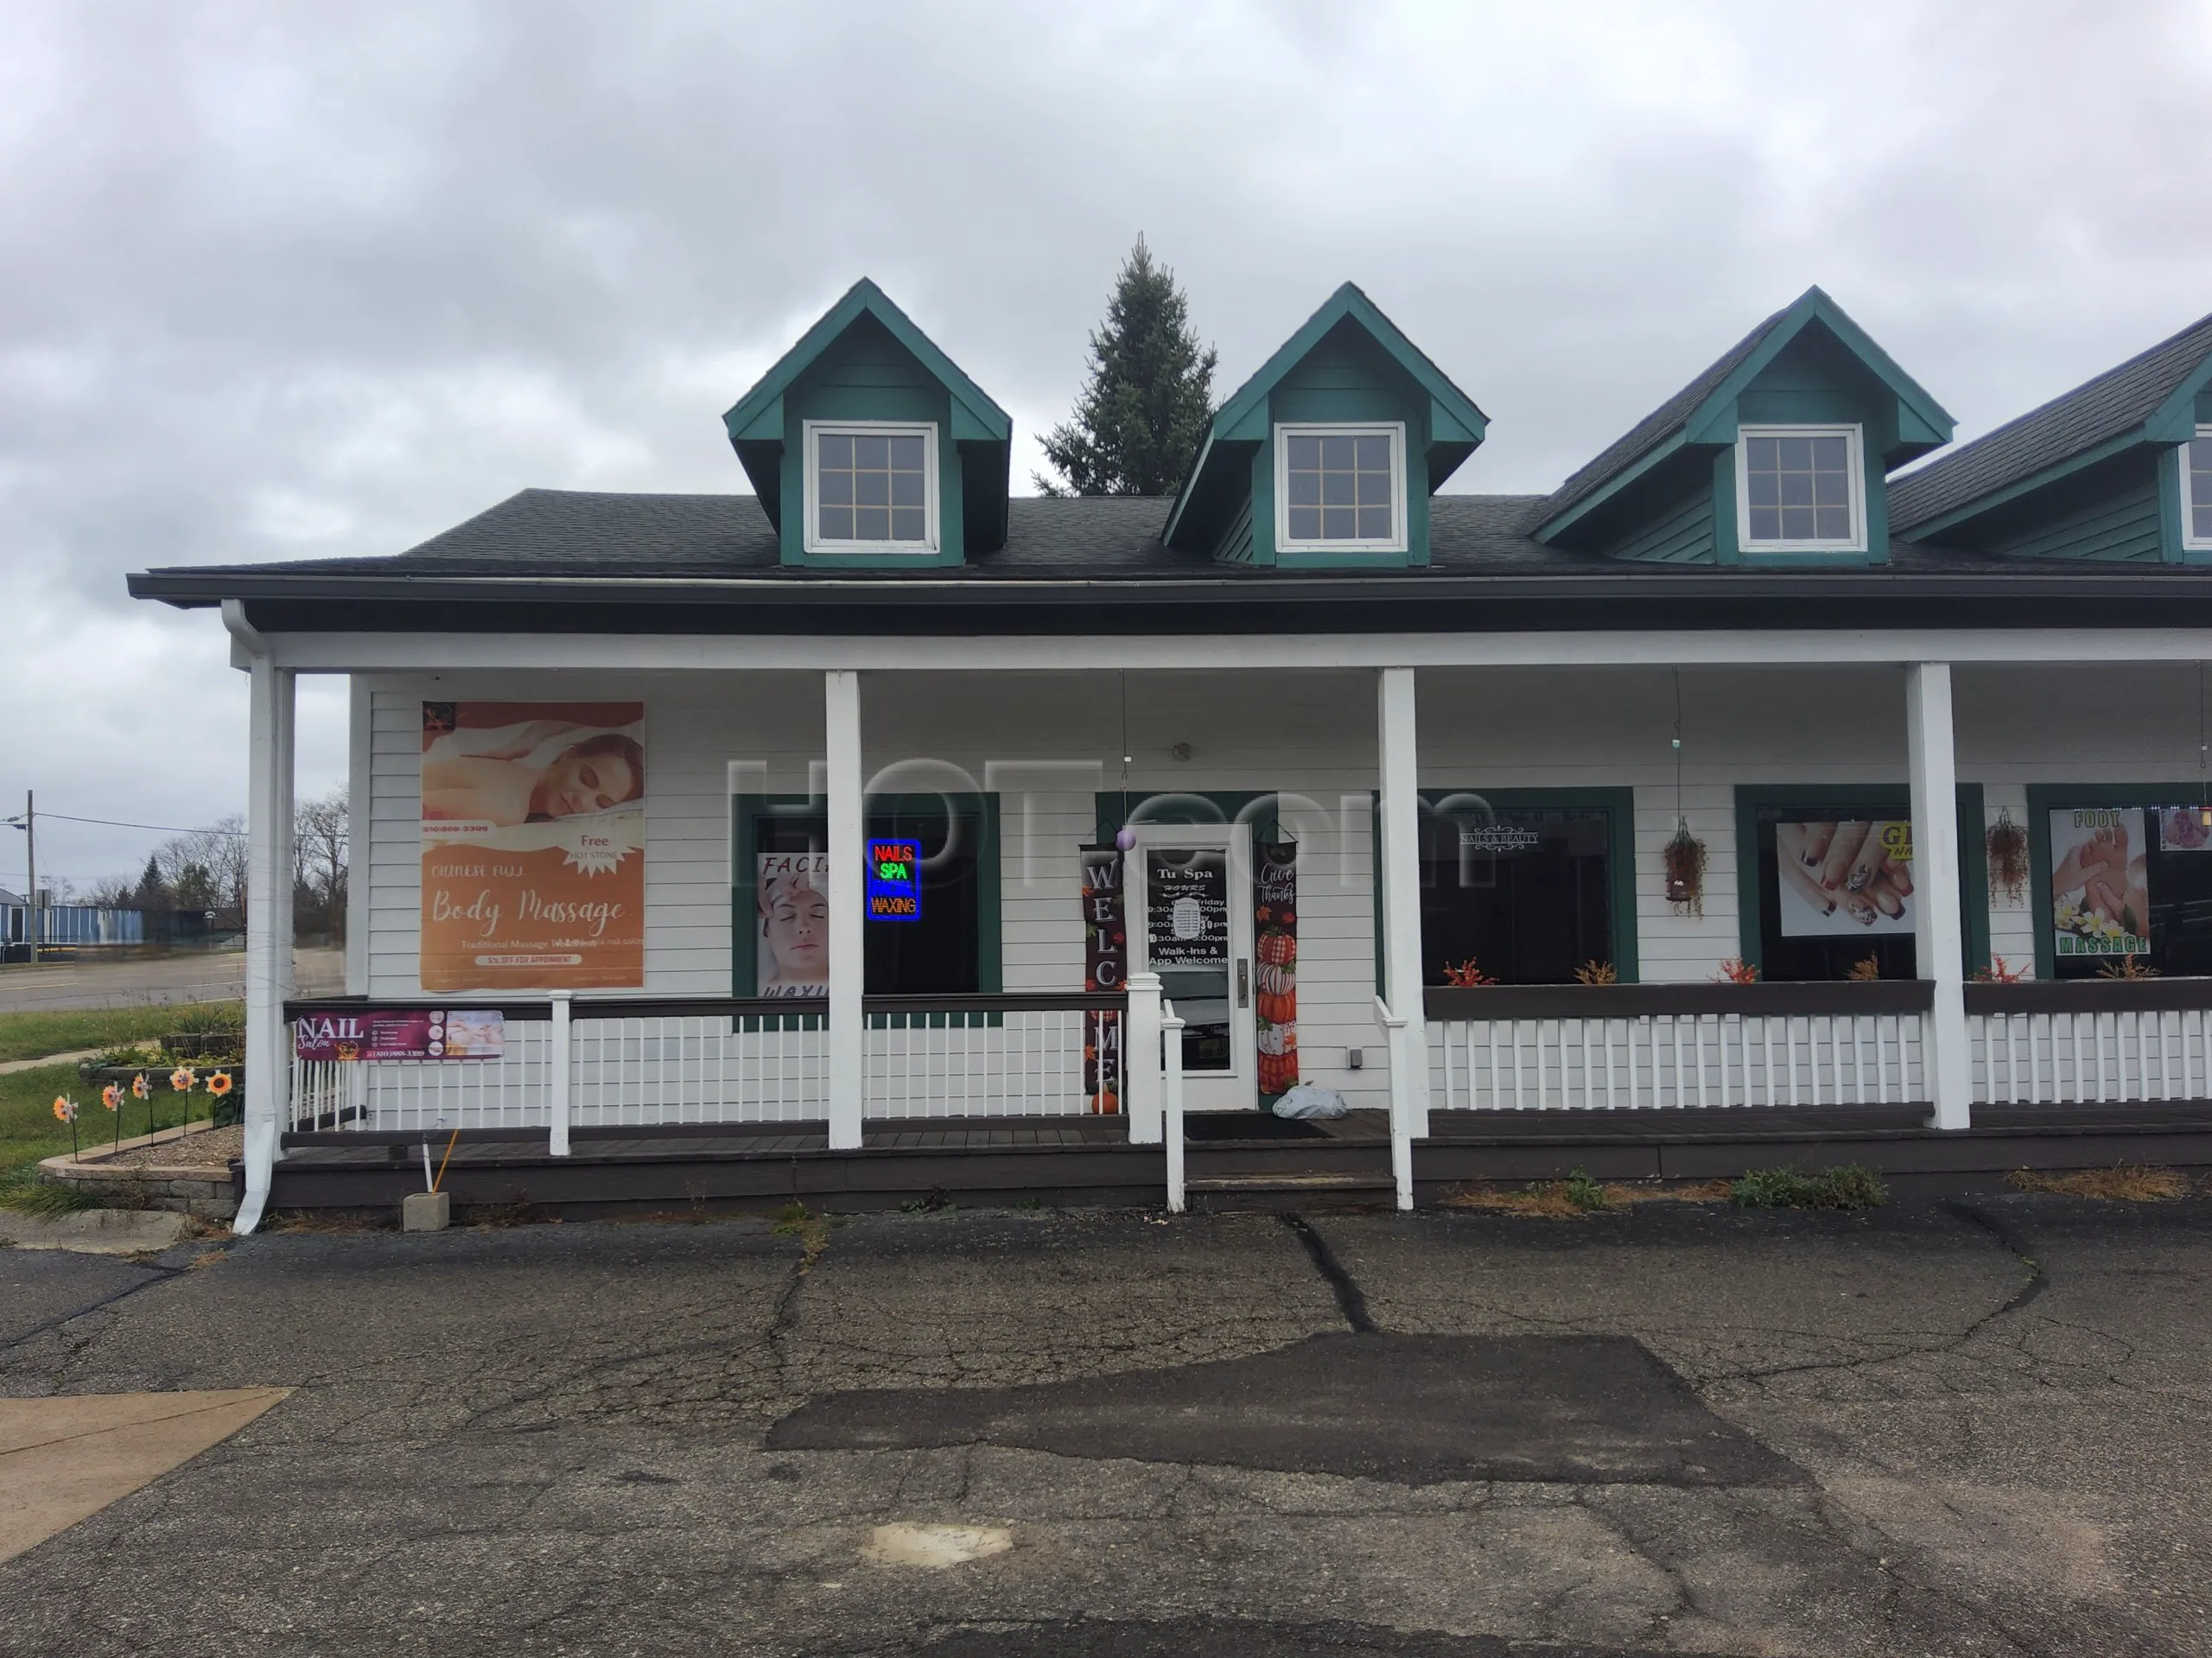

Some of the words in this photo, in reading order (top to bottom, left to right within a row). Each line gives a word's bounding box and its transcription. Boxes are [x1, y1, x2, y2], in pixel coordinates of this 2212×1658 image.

[2074, 810, 2120, 829] FOOT
[581, 835, 609, 846] Free
[874, 845, 913, 861] NAILS
[762, 856, 830, 875] FACI
[880, 862, 908, 880] SPA
[1157, 868, 1177, 880] Tu
[1184, 868, 1213, 880] Spa
[1261, 862, 1294, 885] Give
[1256, 881, 1296, 905] Thanks
[432, 889, 502, 937] Body
[518, 889, 625, 937] Massage
[871, 898, 917, 913] WAXING
[461, 939, 508, 949] Traditional
[511, 939, 549, 950] Massage
[1158, 947, 1206, 956] Walk-Ins
[1210, 946, 1217, 955] &
[2059, 936, 2147, 954] MASSAGE
[296, 1017, 364, 1039] NAIL
[297, 1033, 330, 1051] Salon
